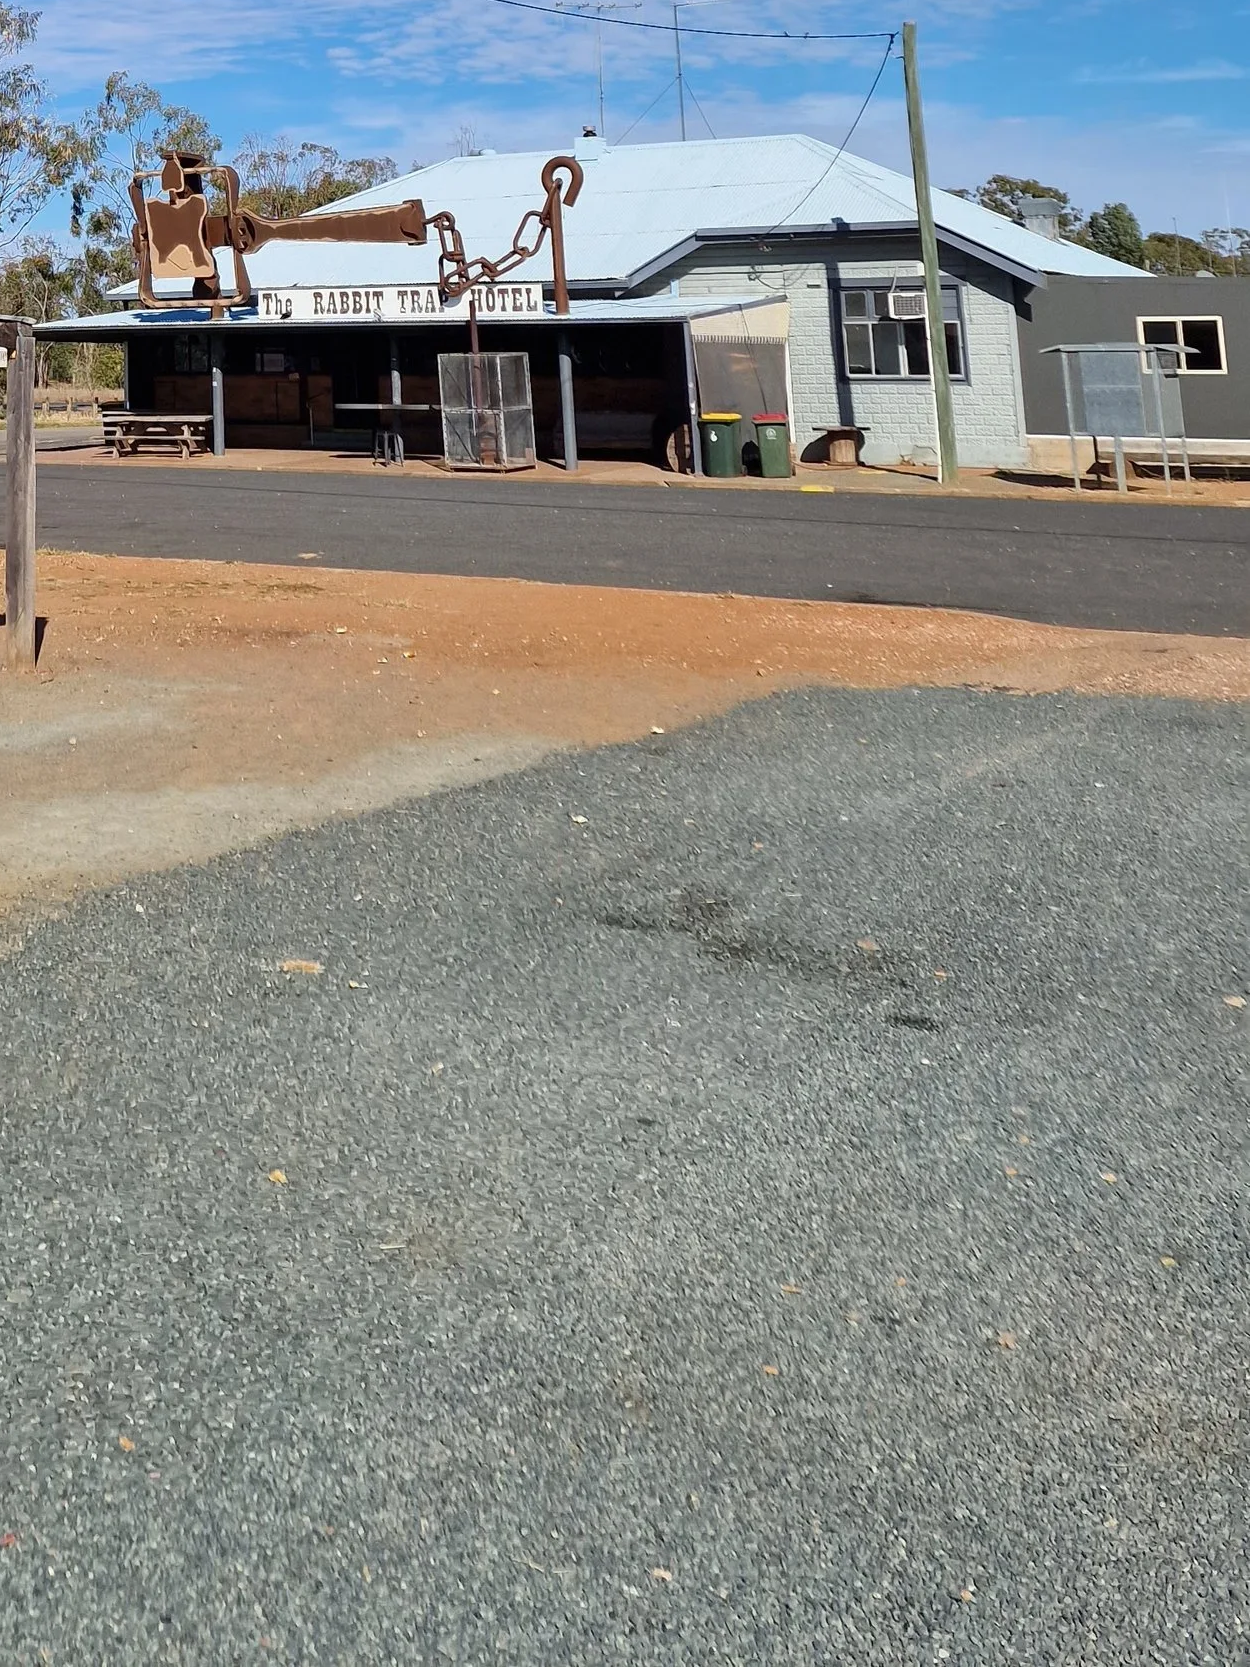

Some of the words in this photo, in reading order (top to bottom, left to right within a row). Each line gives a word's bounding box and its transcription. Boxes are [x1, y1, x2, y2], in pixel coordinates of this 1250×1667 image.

[262, 293, 293, 316] The
[313, 291, 384, 315] RABBIT
[470, 287, 538, 313] HOTEL
